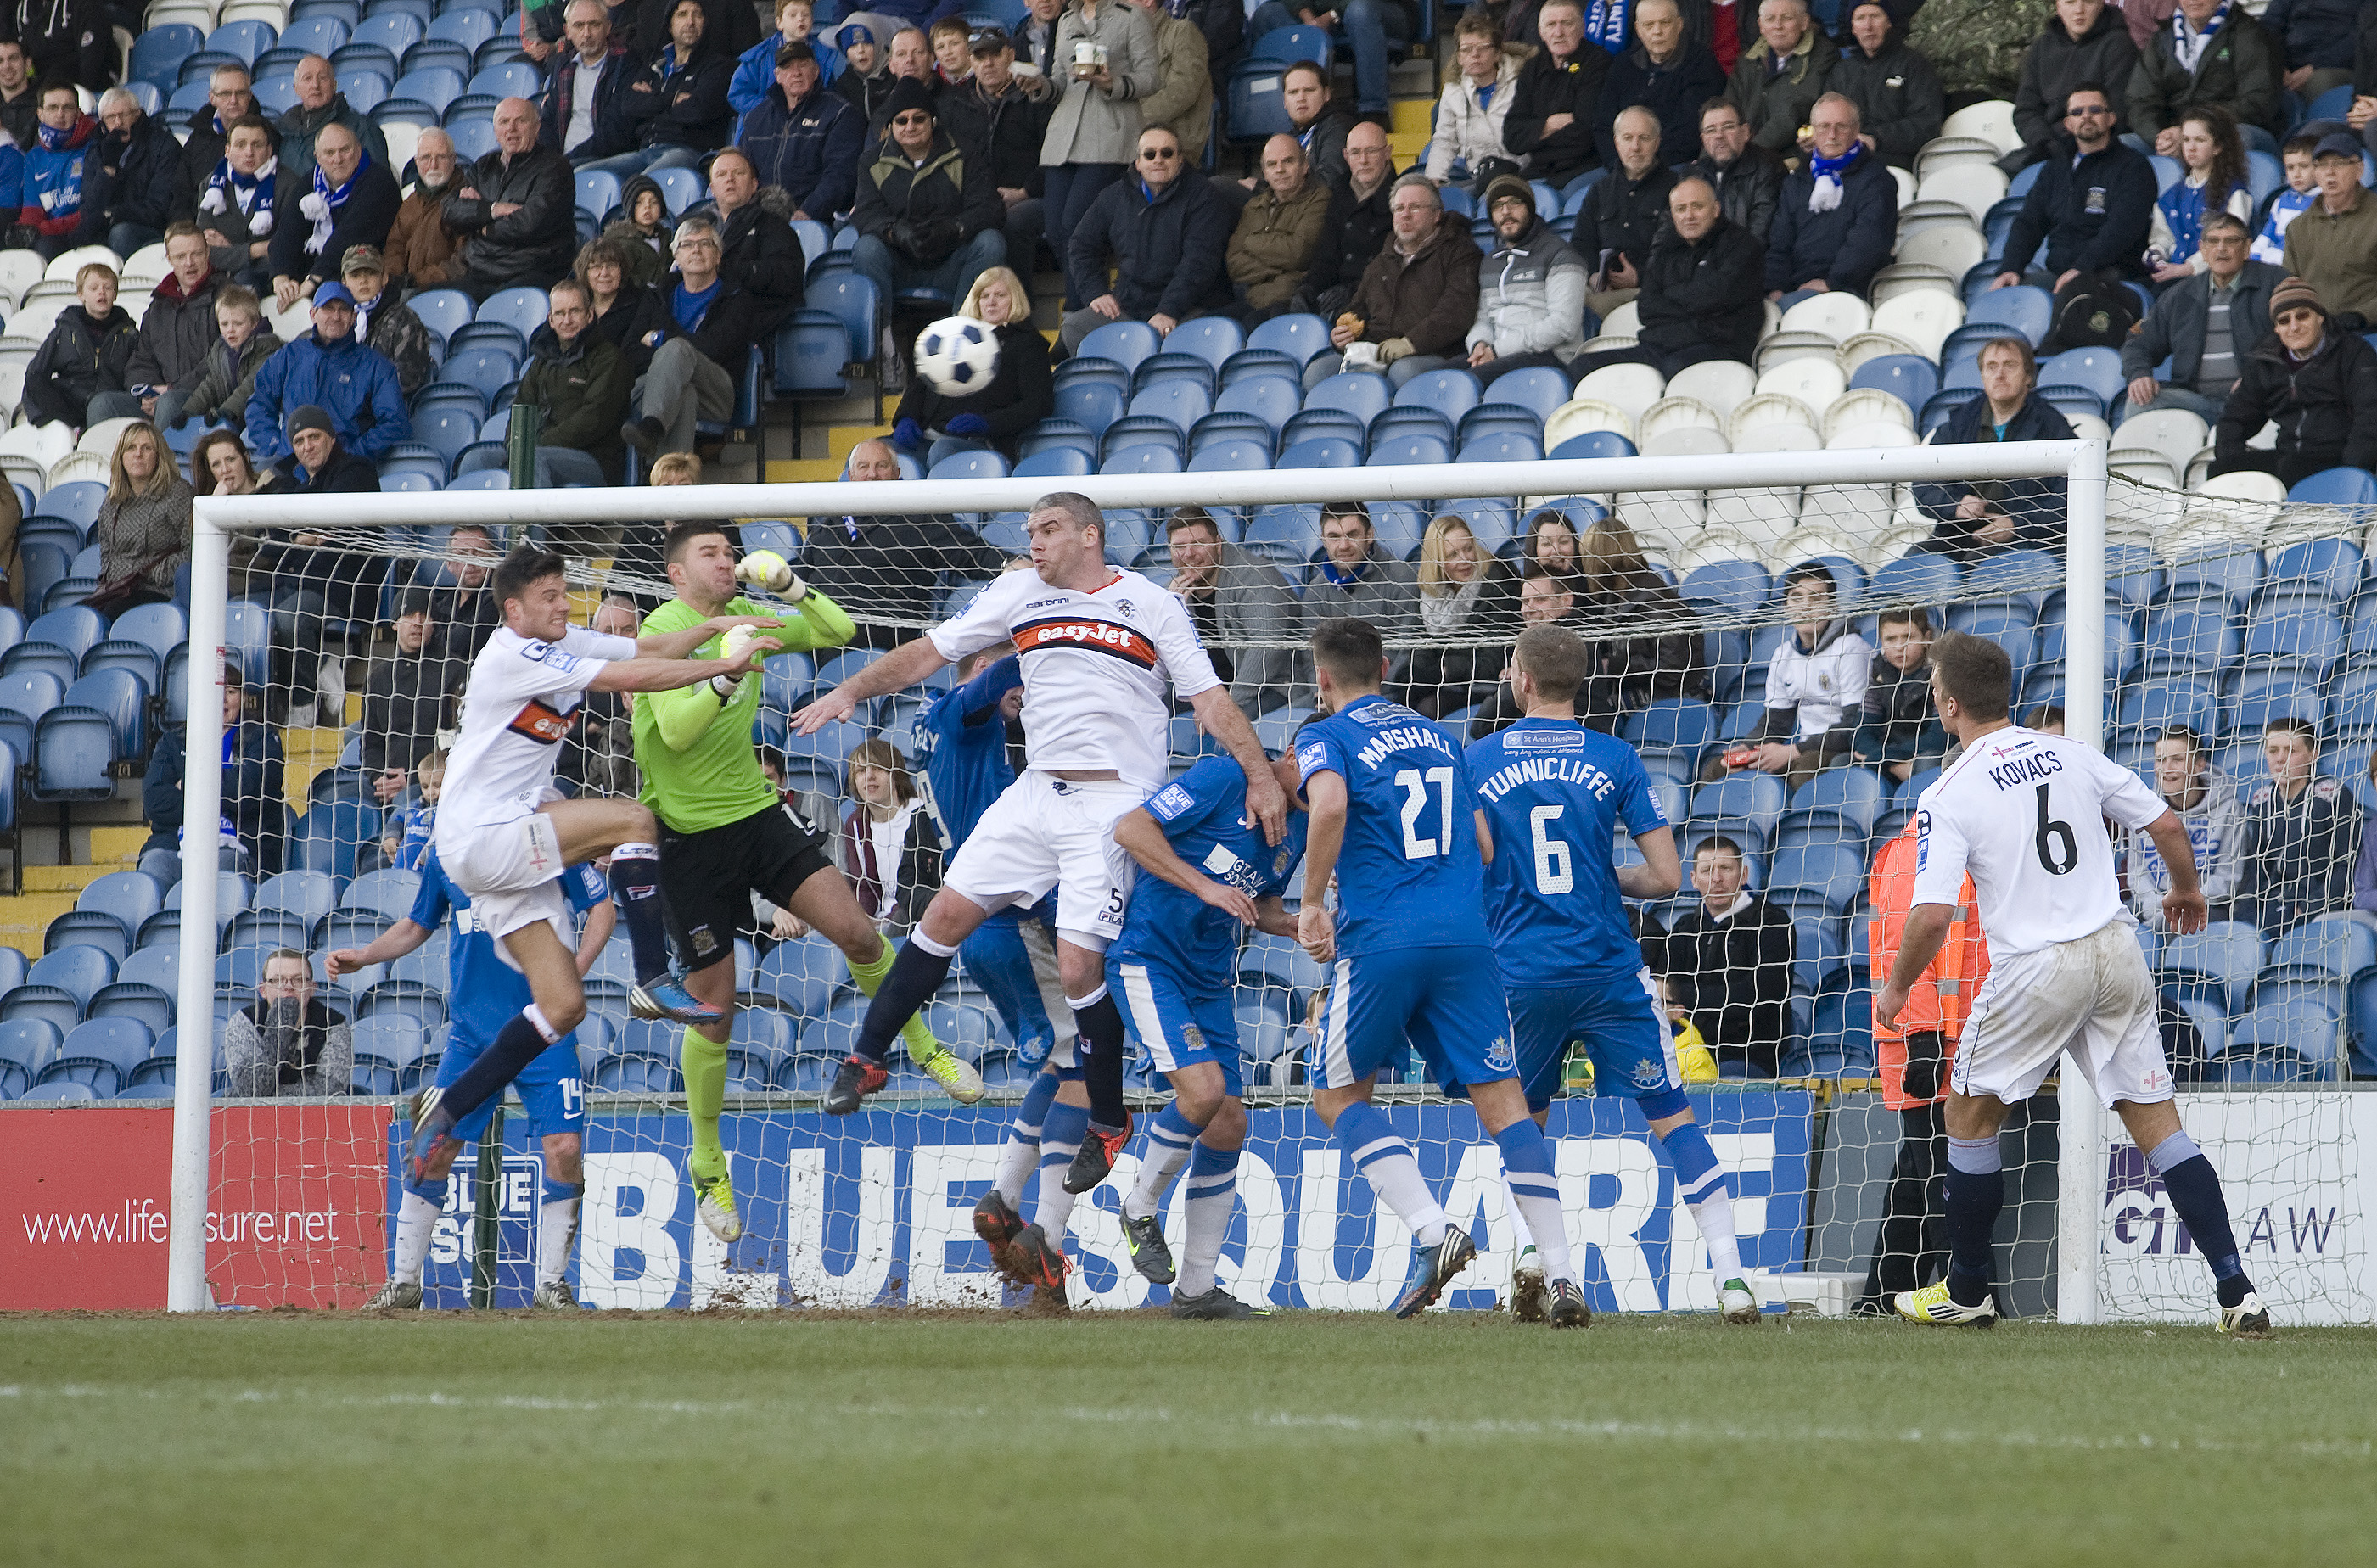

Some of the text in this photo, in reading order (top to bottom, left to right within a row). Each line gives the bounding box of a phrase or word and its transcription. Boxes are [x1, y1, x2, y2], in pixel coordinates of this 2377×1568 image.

[1025, 596, 1070, 609] carbrini
[1037, 624, 1134, 647] easyJet
[1357, 725, 1455, 770] MARSHALL
[1477, 757, 1616, 803] TUNNICLIFFE
[1988, 750, 2063, 791] KOVACS
[1160, 792, 1176, 806] SQ
[1168, 786, 1191, 808] BLUE
[1394, 766, 1454, 860] 21
[2035, 782, 2078, 876] 6
[1530, 804, 1573, 895] 6
[1108, 888, 1124, 913] 5
[558, 1078, 584, 1111] 14
[579, 1132, 1775, 1313] BLUE SQUARE
[2097, 1266, 2321, 1295] Solicors
